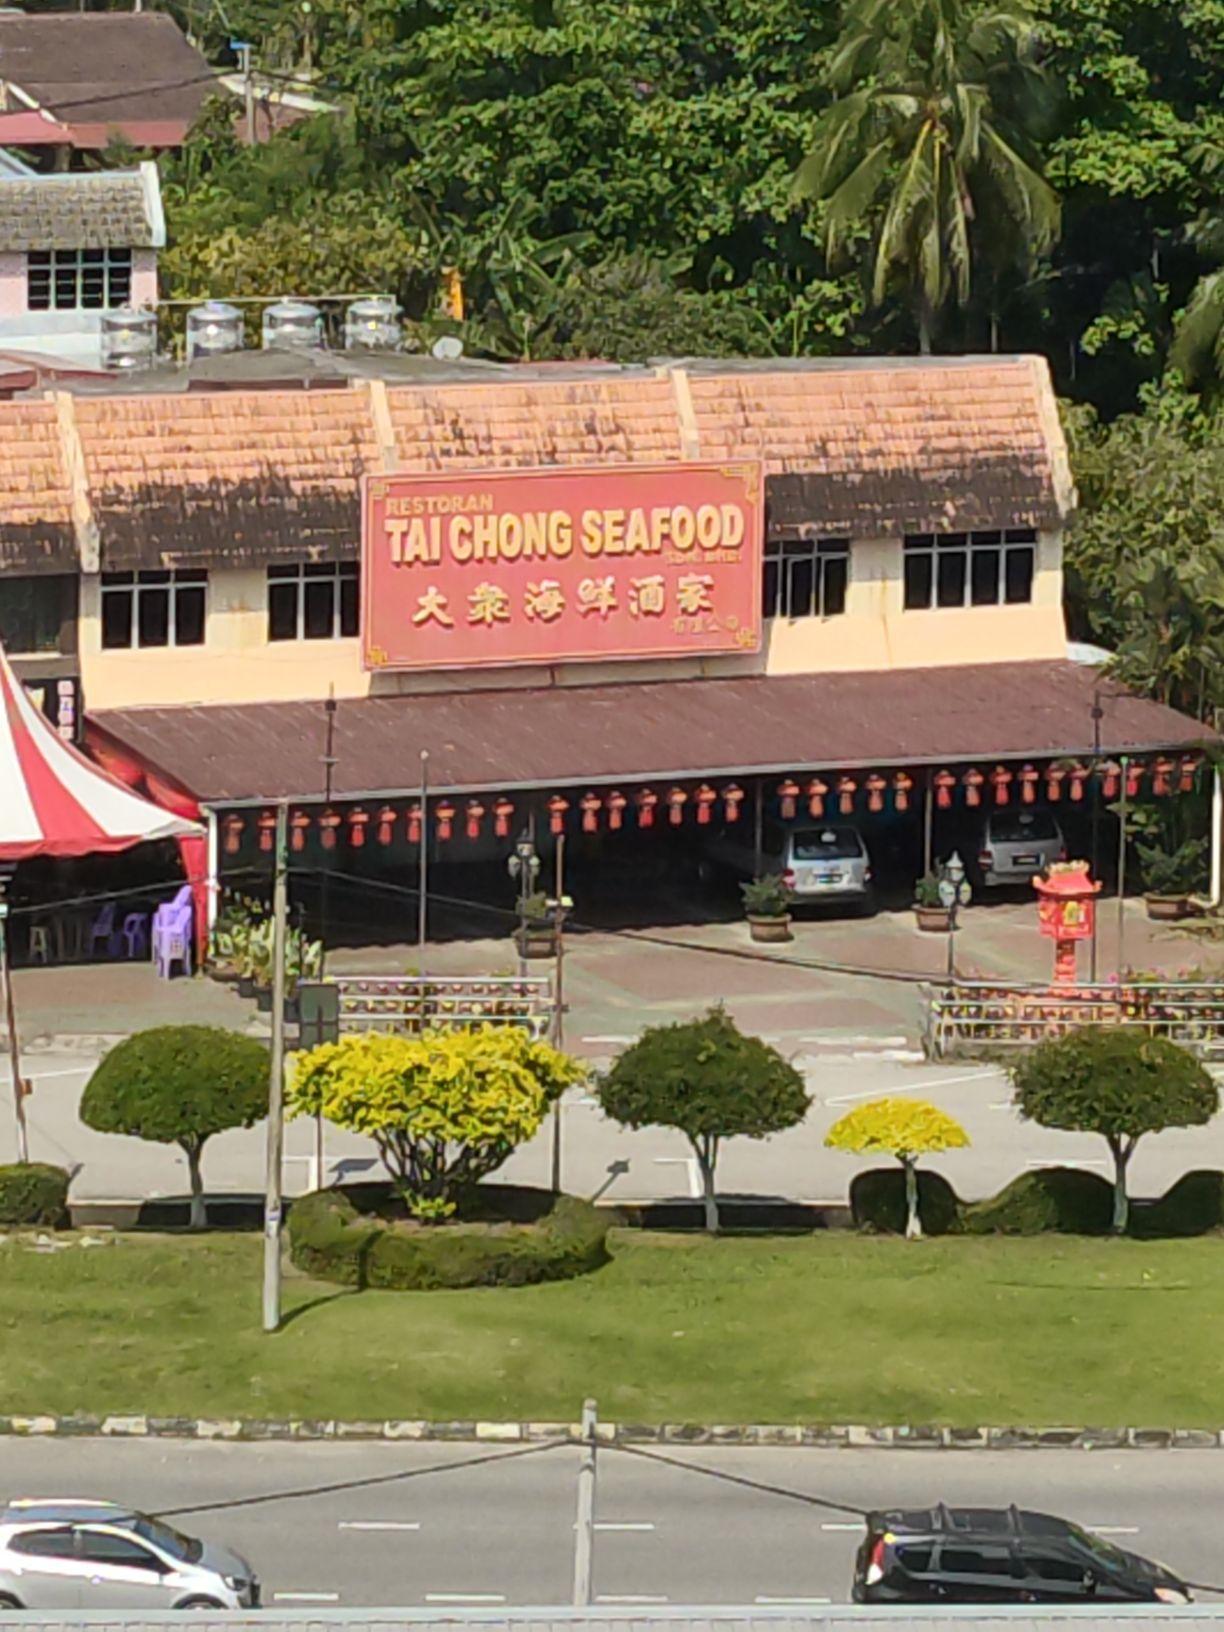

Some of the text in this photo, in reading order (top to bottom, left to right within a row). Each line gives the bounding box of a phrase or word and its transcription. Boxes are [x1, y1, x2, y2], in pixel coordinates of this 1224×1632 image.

[385, 494, 493, 515] RESTORAN
[385, 504, 744, 563] TAI CHONG SEAFOOD
